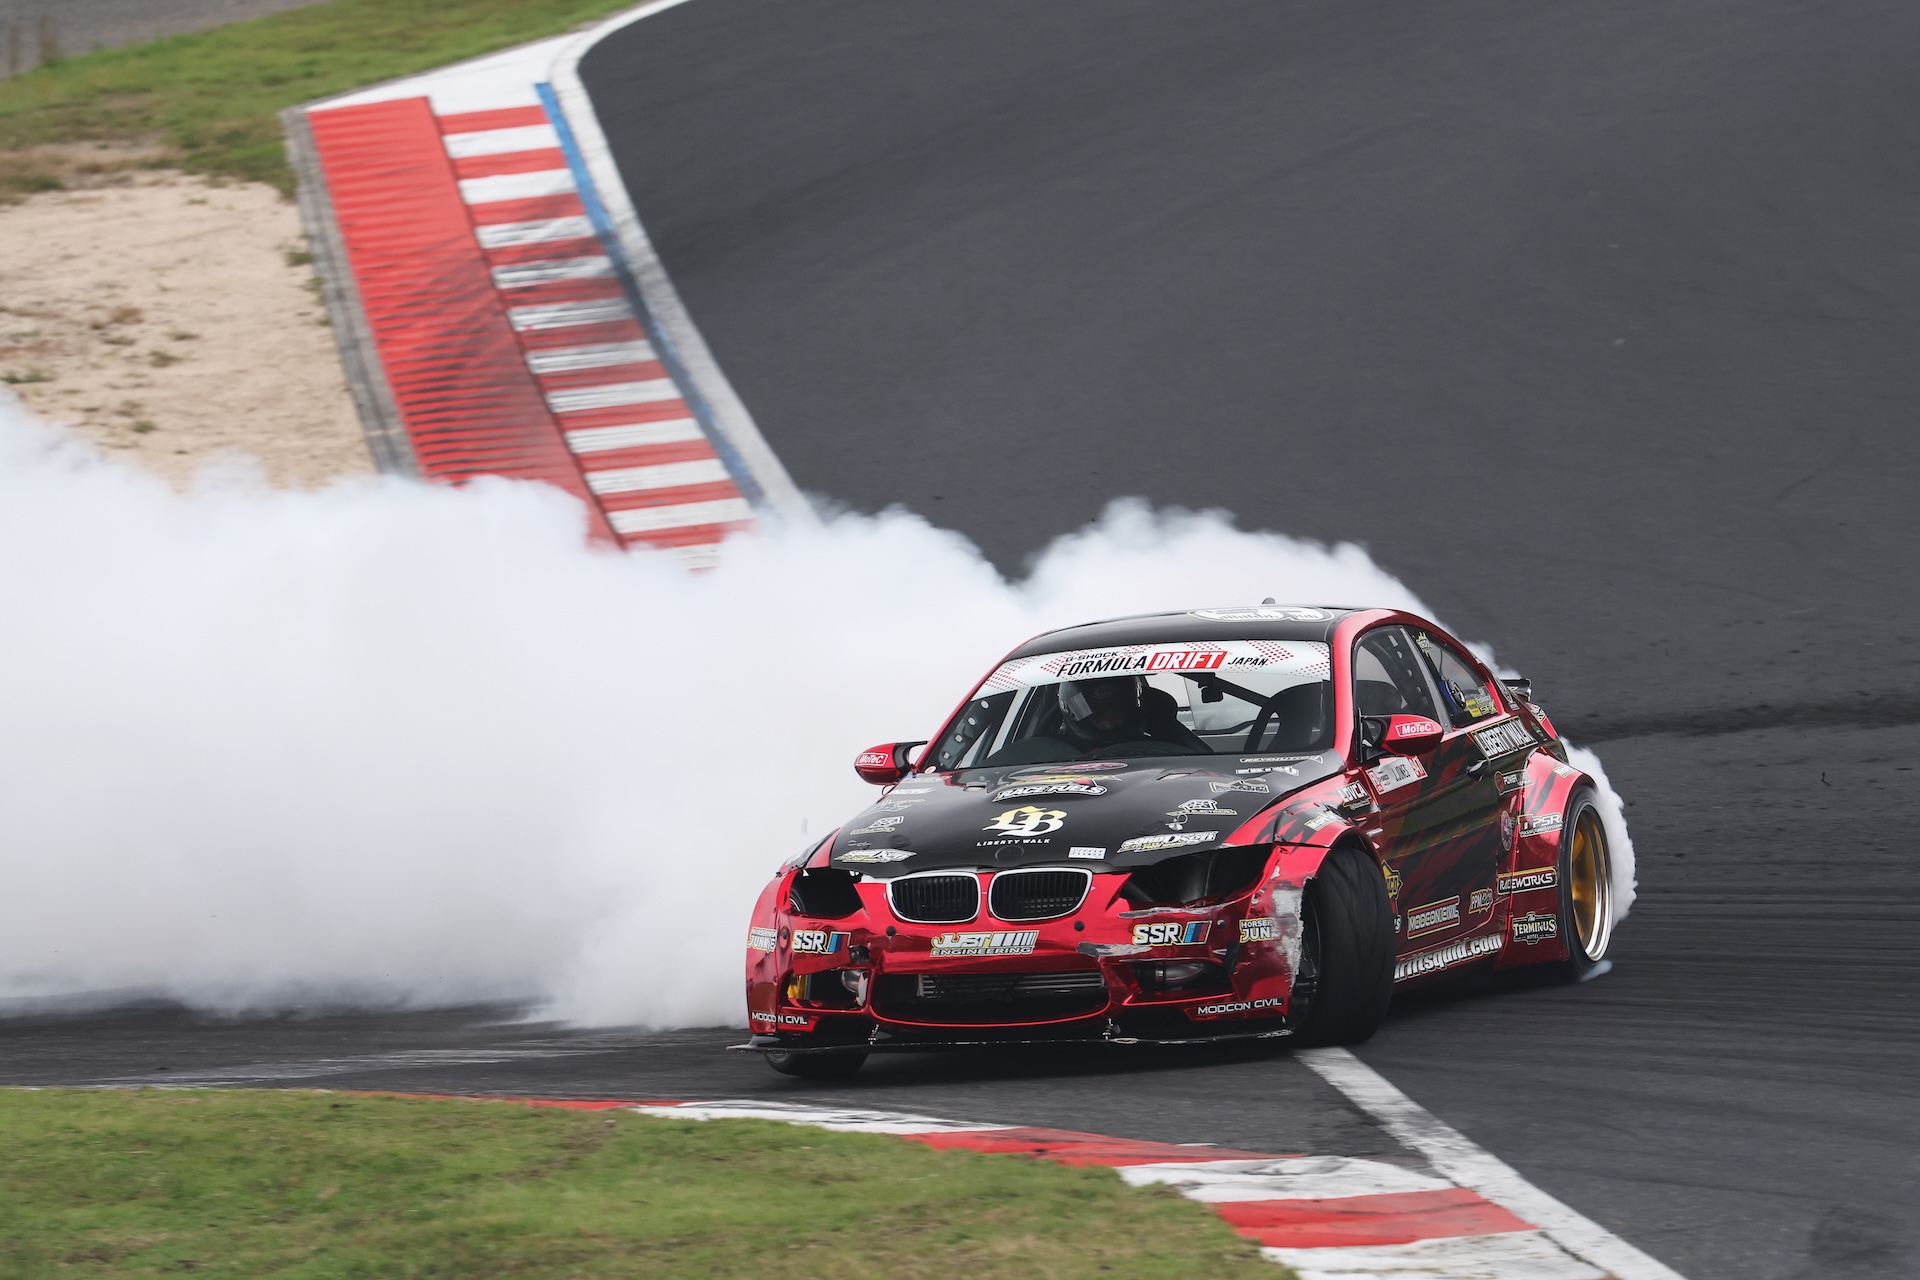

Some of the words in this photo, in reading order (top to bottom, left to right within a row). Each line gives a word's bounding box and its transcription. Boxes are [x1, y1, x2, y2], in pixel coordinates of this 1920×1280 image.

[1066, 651, 1118, 662] G-SHOCK
[1056, 656, 1148, 678] FORMULA
[1151, 652, 1221, 670] DRIFT
[1228, 657, 1269, 666] JAPAN
[1402, 723, 1432, 735] MoTeC
[859, 753, 884, 764] MoTeC
[999, 785, 1044, 799] RACE
[1513, 919, 1557, 935] TERMINUS
[792, 931, 826, 952] SSR
[1135, 924, 1179, 945] SSR
[932, 946, 1032, 956] ENGINEERING
[1198, 1002, 1251, 1014] MODCON
[1254, 998, 1282, 1008] CIVIL
[785, 1015, 808, 1025] CIVIL
